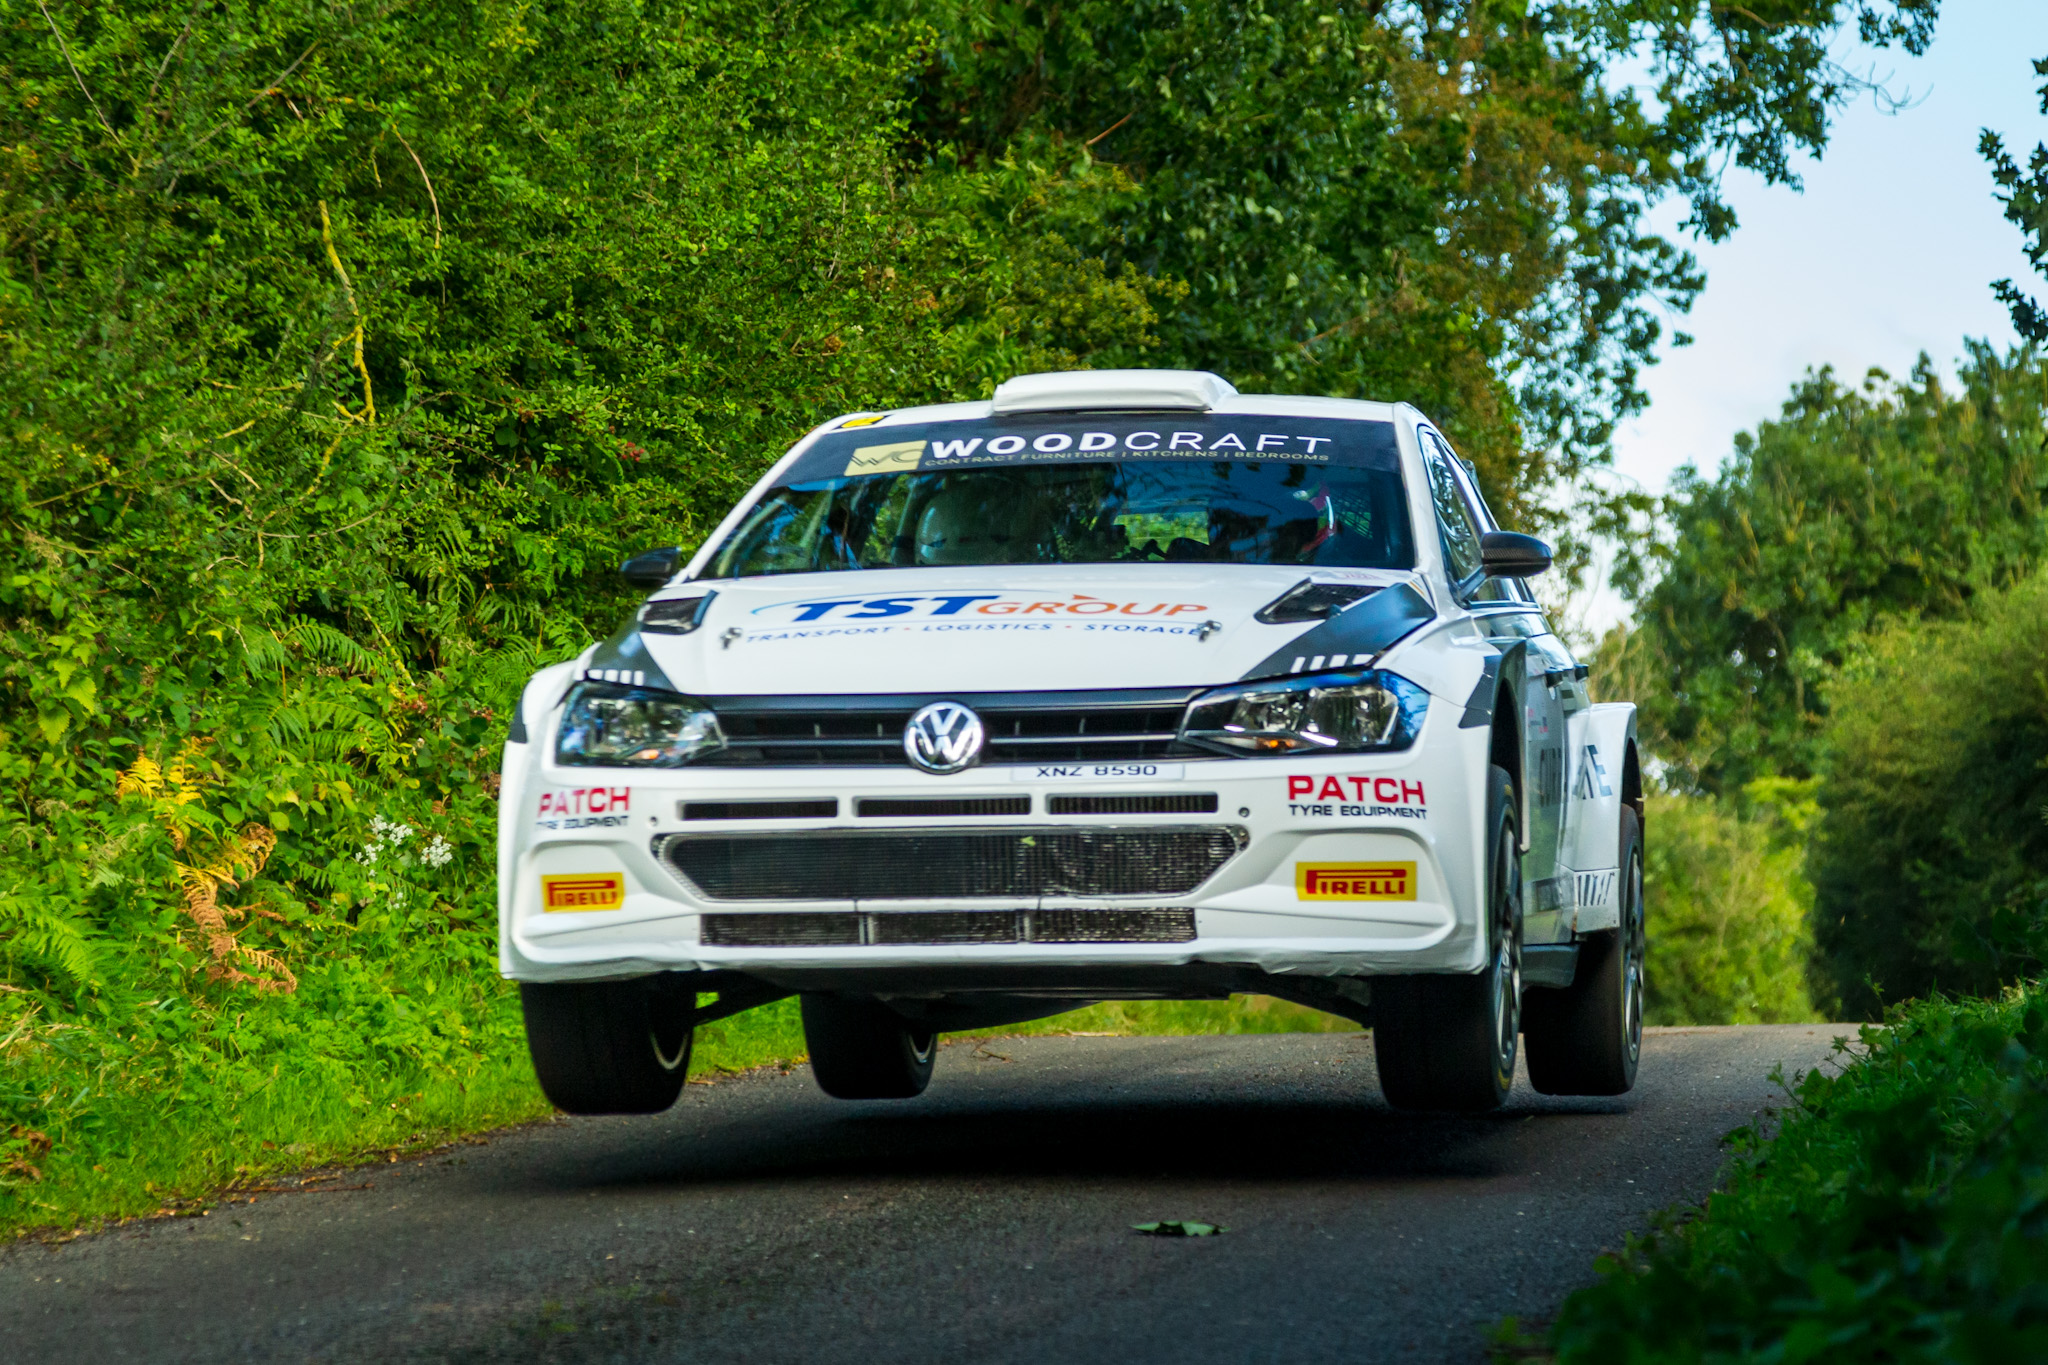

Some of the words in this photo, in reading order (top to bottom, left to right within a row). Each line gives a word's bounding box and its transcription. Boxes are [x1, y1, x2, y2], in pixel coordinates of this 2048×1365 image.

[931, 431, 1332, 459] WOODCRAFT
[924, 455, 1015, 467] CONTRACT
[1021, 450, 1116, 461] FURNITURE
[1132, 450, 1218, 458] KITCHENS
[1234, 451, 1330, 461] BEDROOMS
[746, 626, 894, 643] TRANSPORT
[922, 623, 1053, 633] LOGISTICS
[1036, 766, 1083, 778] XNZ
[1095, 765, 1158, 776] 8590
[536, 786, 631, 818] PATCH
[1287, 775, 1426, 805] PATCH
[1289, 804, 1333, 816] TYRE
[1340, 805, 1427, 819] EQUIPMENT
[546, 879, 618, 908] PIRELLI
[1306, 869, 1407, 895] PIRELLI
